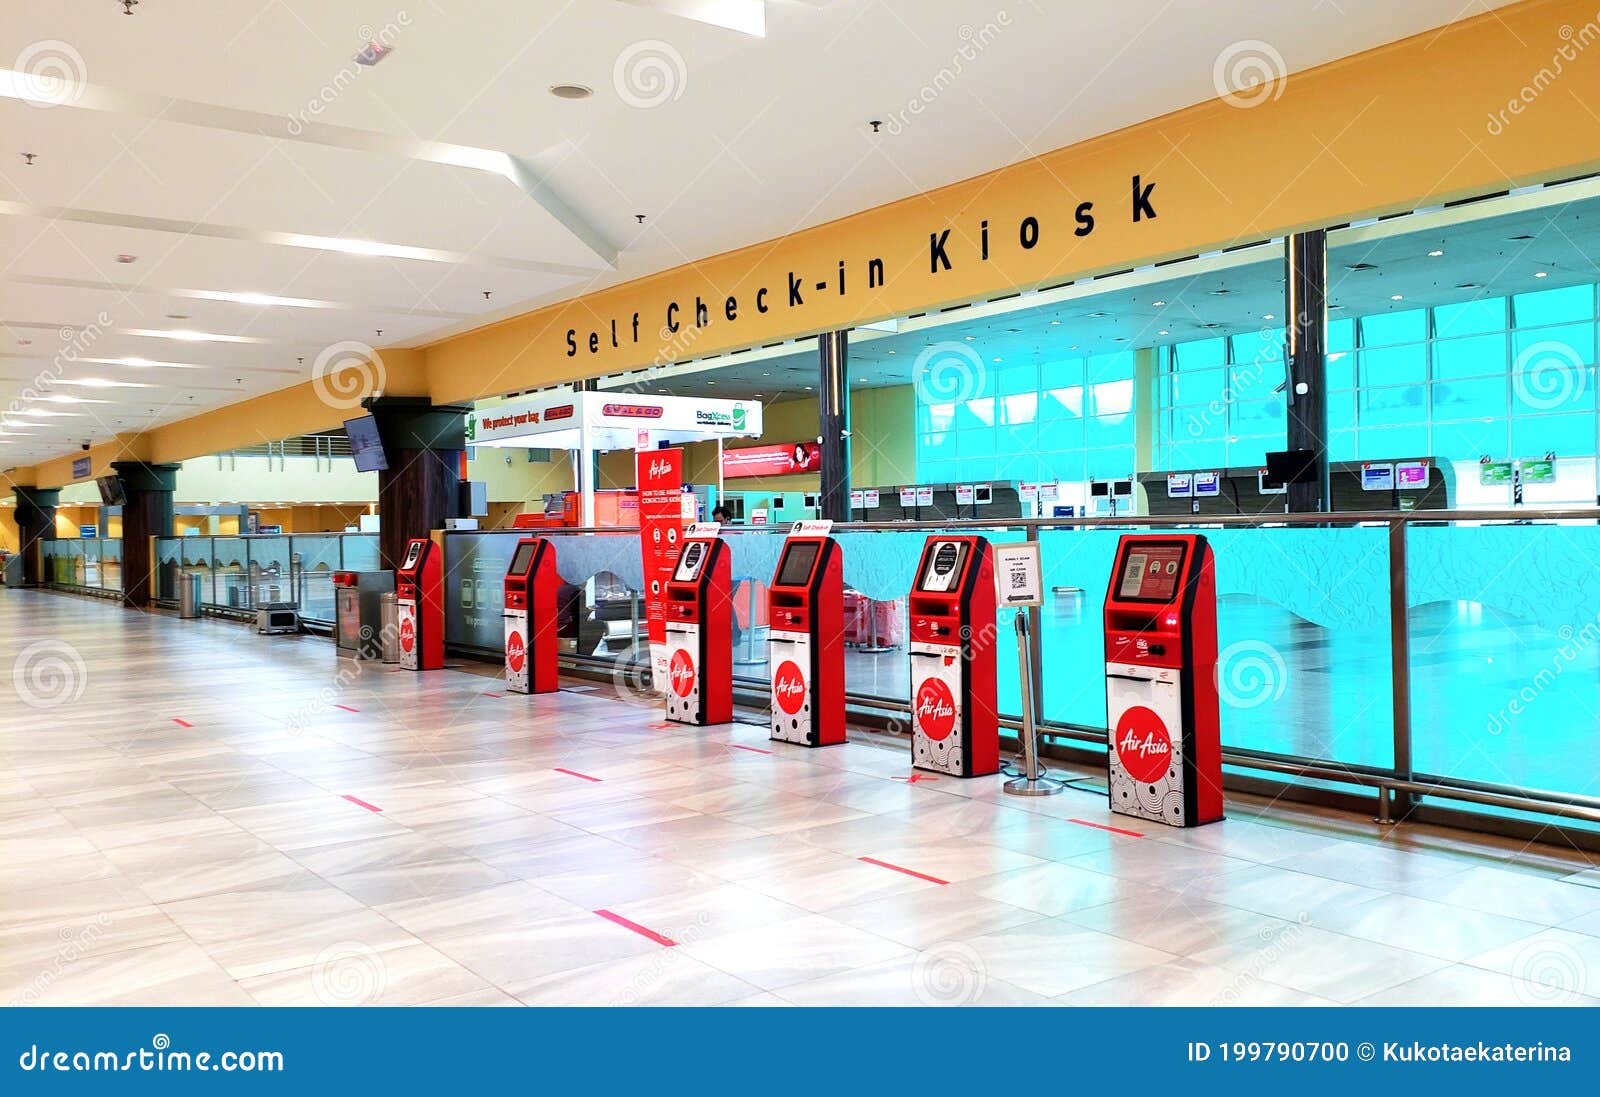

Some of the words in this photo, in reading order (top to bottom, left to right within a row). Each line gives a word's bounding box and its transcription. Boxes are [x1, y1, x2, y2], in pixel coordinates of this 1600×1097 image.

[566, 312, 640, 357] Self
[667, 257, 884, 333] Check-in
[930, 174, 1157, 274] Kiosk
[482, 417, 492, 429] We
[528, 410, 540, 424] bag
[919, 696, 953, 721] AirAsia
[1120, 728, 1169, 759] AirAsia
